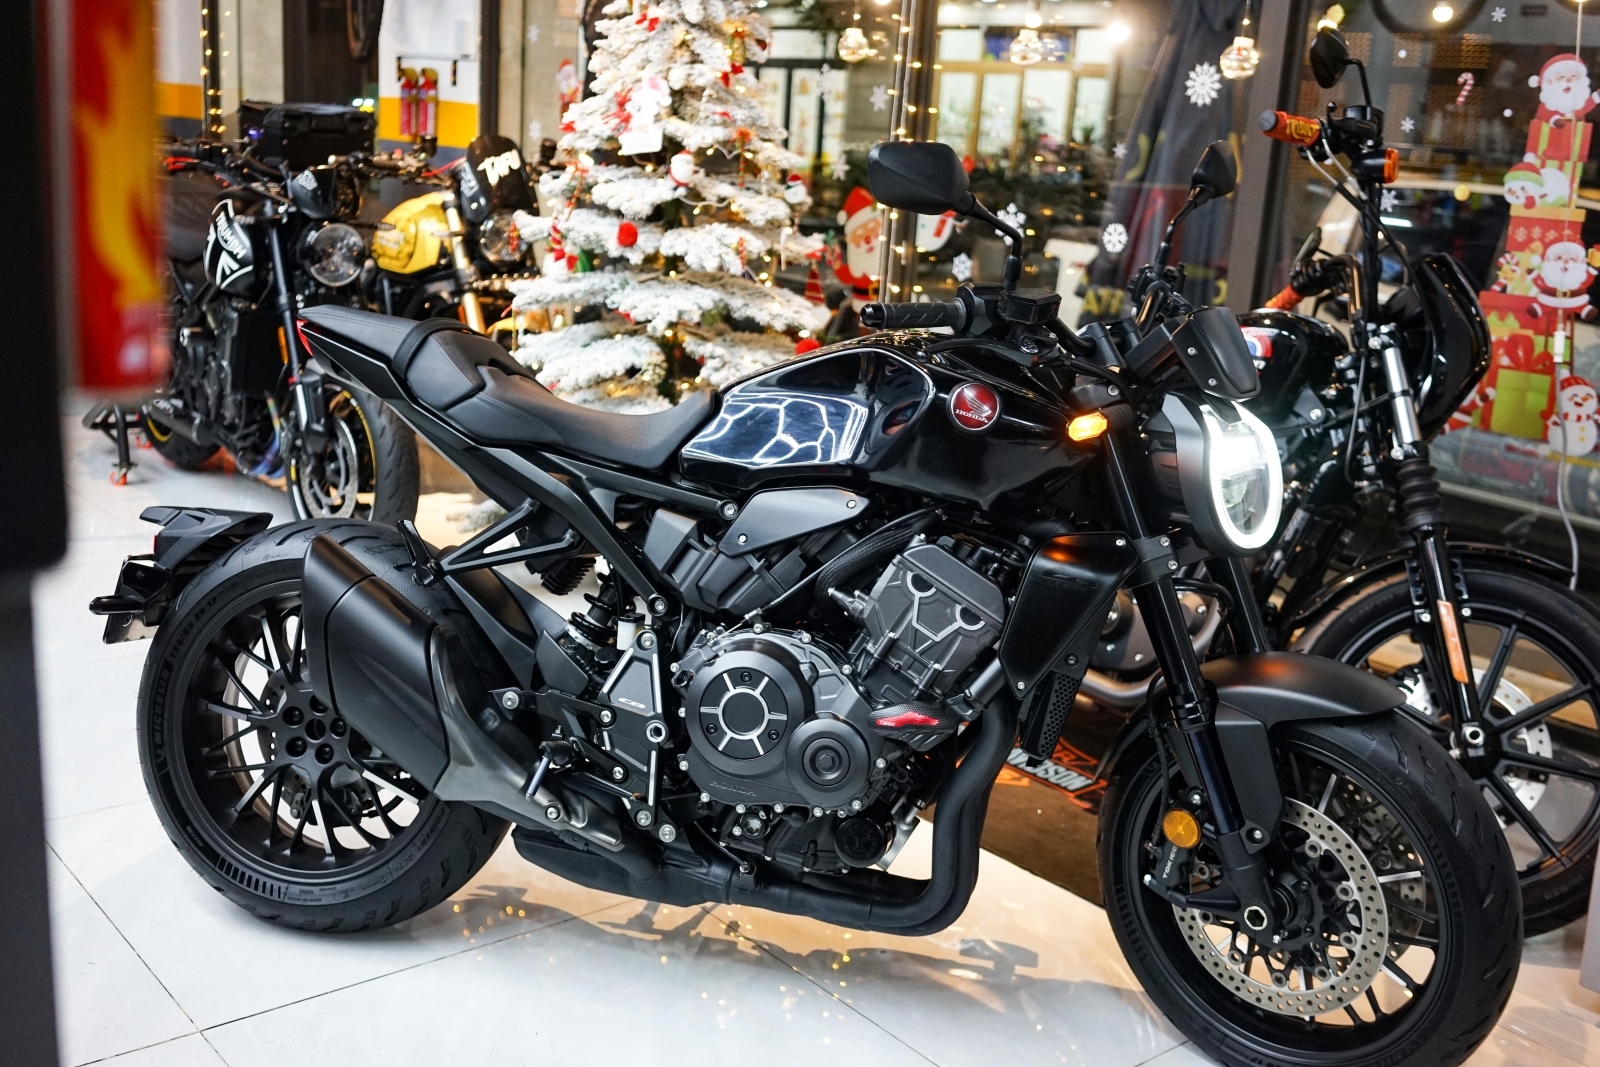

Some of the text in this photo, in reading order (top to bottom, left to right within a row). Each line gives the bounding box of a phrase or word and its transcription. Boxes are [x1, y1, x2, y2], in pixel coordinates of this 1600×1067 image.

[215, 210, 248, 260] TRIUMPH
[955, 408, 990, 424] HONDA
[151, 596, 219, 745] MICHELIN 190/55 ZR 17
